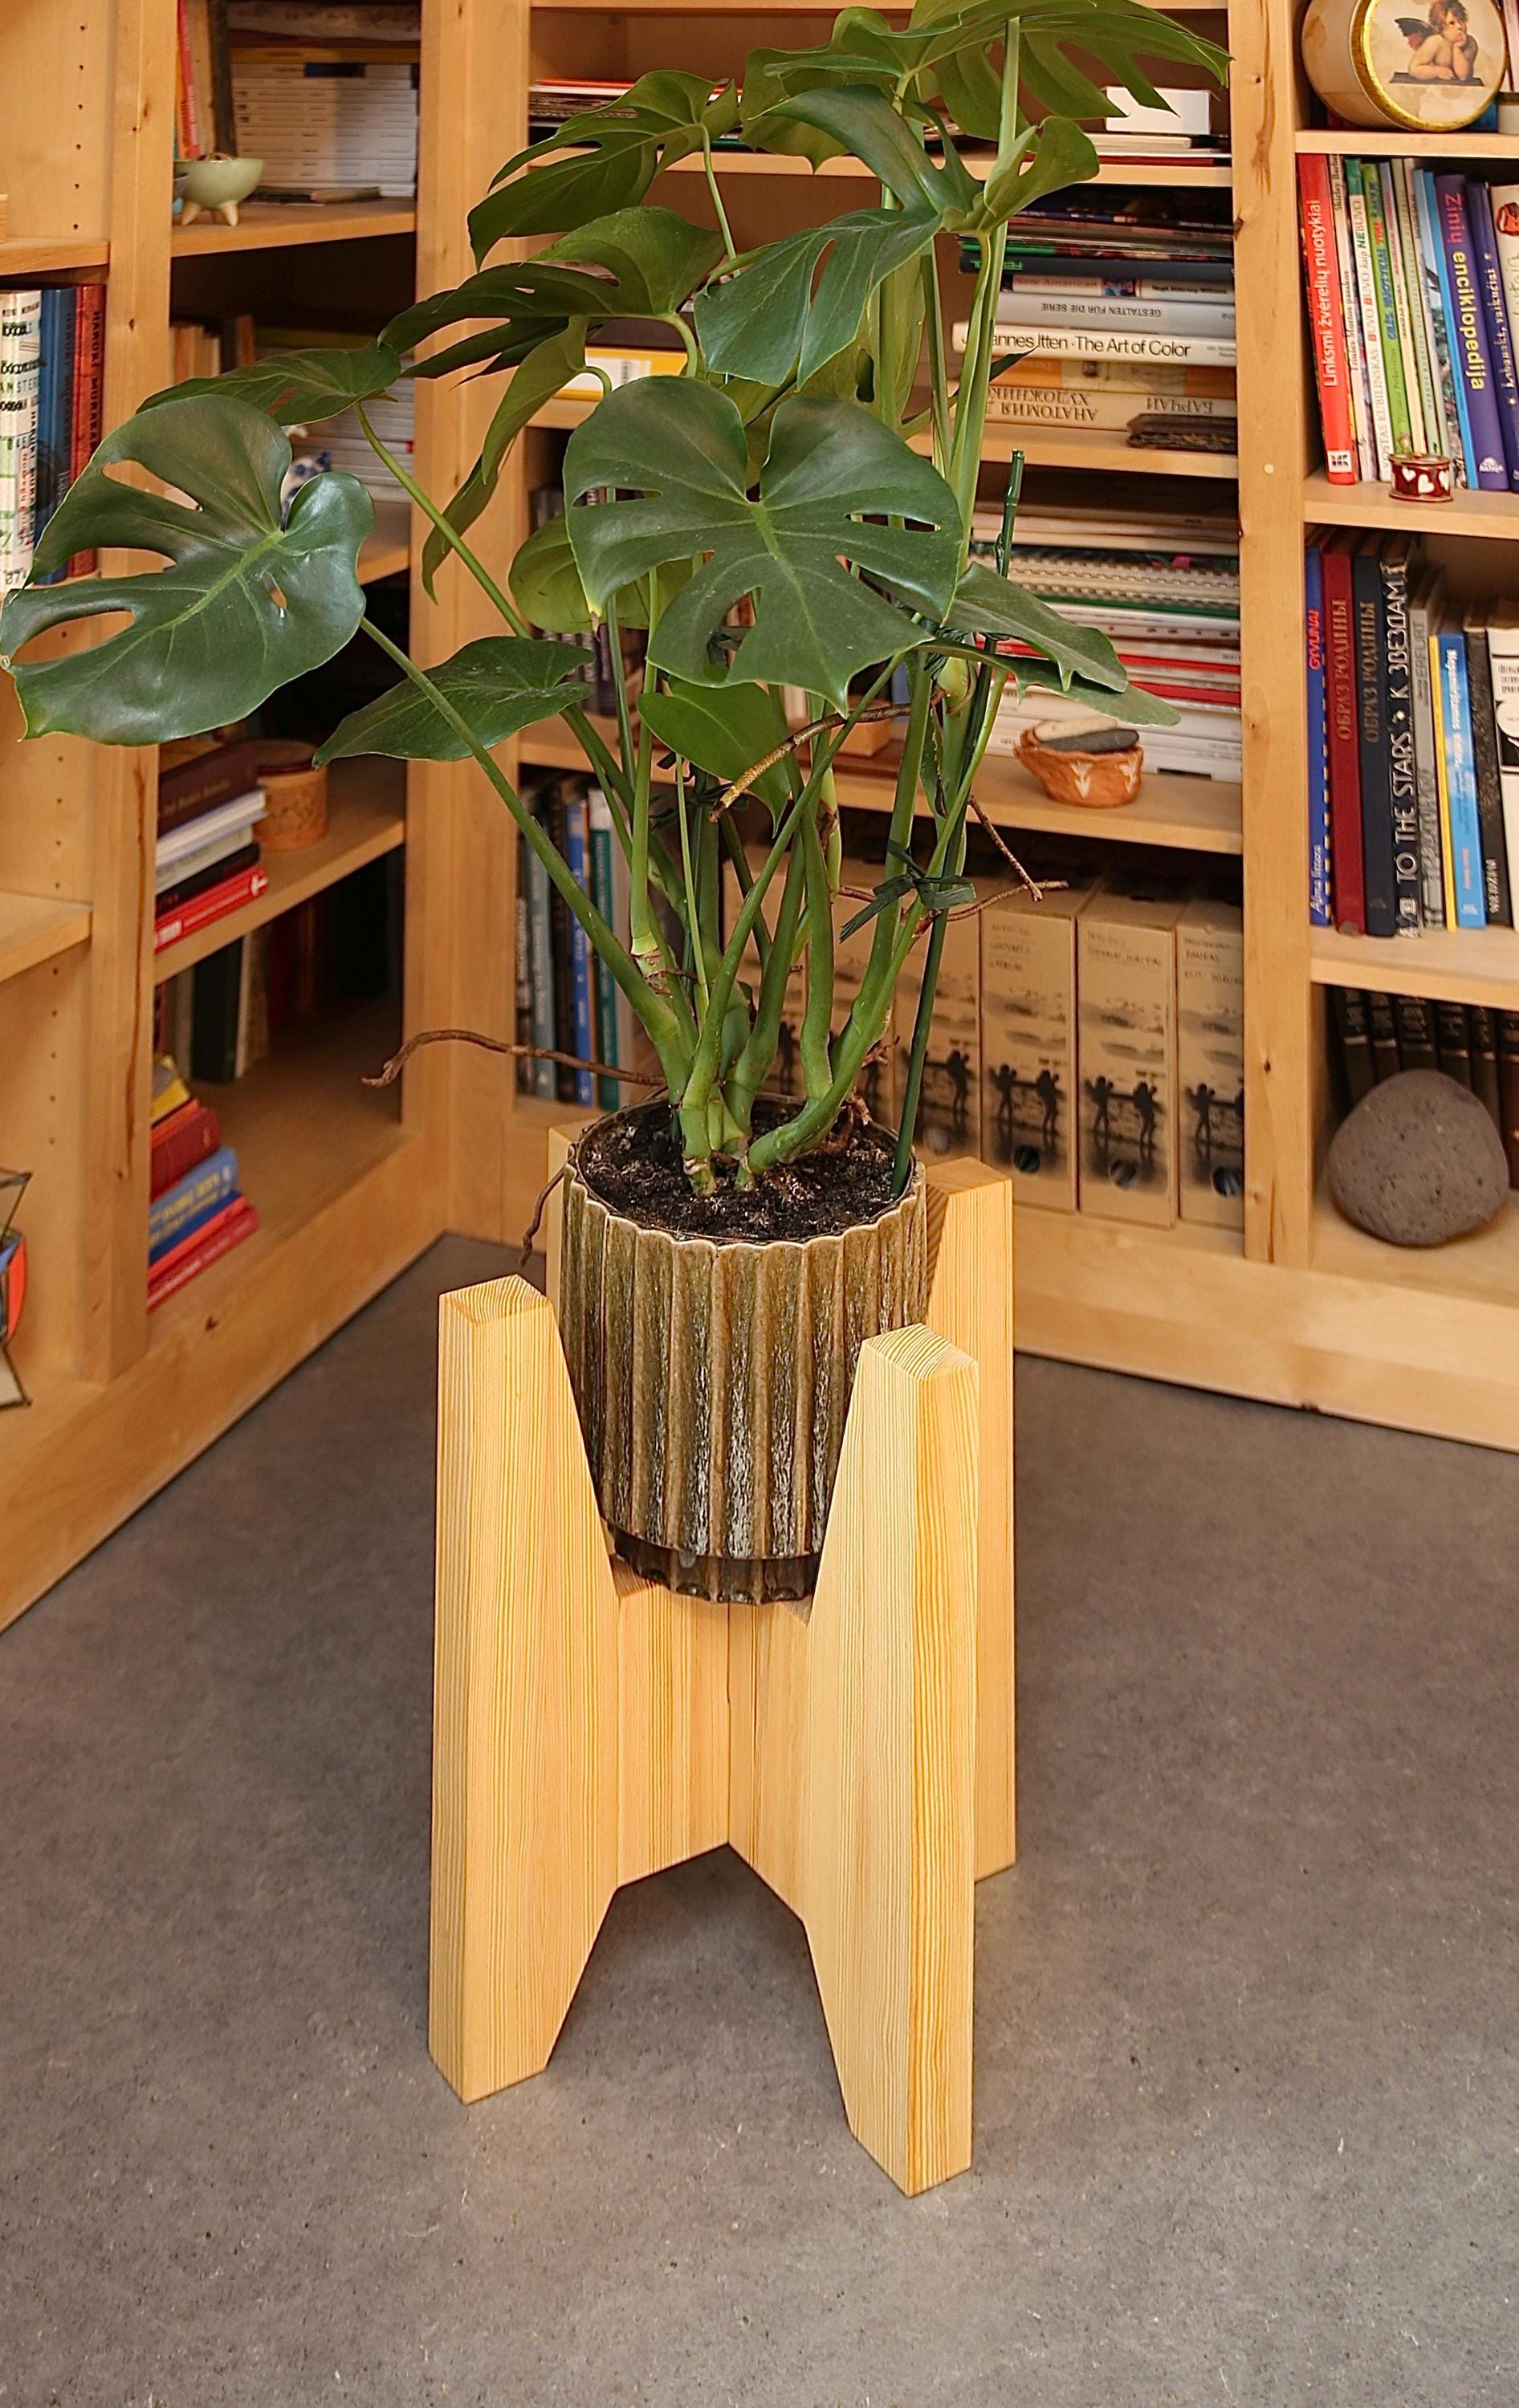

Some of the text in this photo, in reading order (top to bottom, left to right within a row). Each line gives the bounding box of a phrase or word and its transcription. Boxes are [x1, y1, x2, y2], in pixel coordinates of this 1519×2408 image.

[1354, 200, 1366, 250] NEBUVO
[1309, 198, 1338, 388] Linksmi žvėrelių nuotykiai
[1342, 270, 1353, 304] pasakos
[1362, 272, 1374, 306] BUVO
[1445, 193, 1485, 390] Žinių enciklopedija
[1041, 302, 1162, 318] GESTALTEN FÜR DIE SERIE
[1346, 306, 1355, 338] Mortos
[1366, 309, 1377, 343] BUVO
[1037, 332, 1068, 350] Itten
[1075, 336, 1104, 353] The
[1107, 337, 1132, 355] Art
[1131, 338, 1146, 355] of
[1148, 340, 1191, 358] Color
[88, 311, 101, 458] HARUKI MURAKAM
[1000, 402, 1098, 421] АНАТОМИЯ
[1383, 579, 1408, 677] ЗВЕЗДАМ
[1411, 620, 1427, 678] ERFURT
[1330, 598, 1352, 740] ОБРАЗ РОДИНЫ
[1358, 600, 1379, 743] ОБРАЗ РОДИНЫ
[1391, 806, 1416, 846] THE
[1395, 852, 1419, 885] TO
[1309, 880, 1325, 914] Alma
